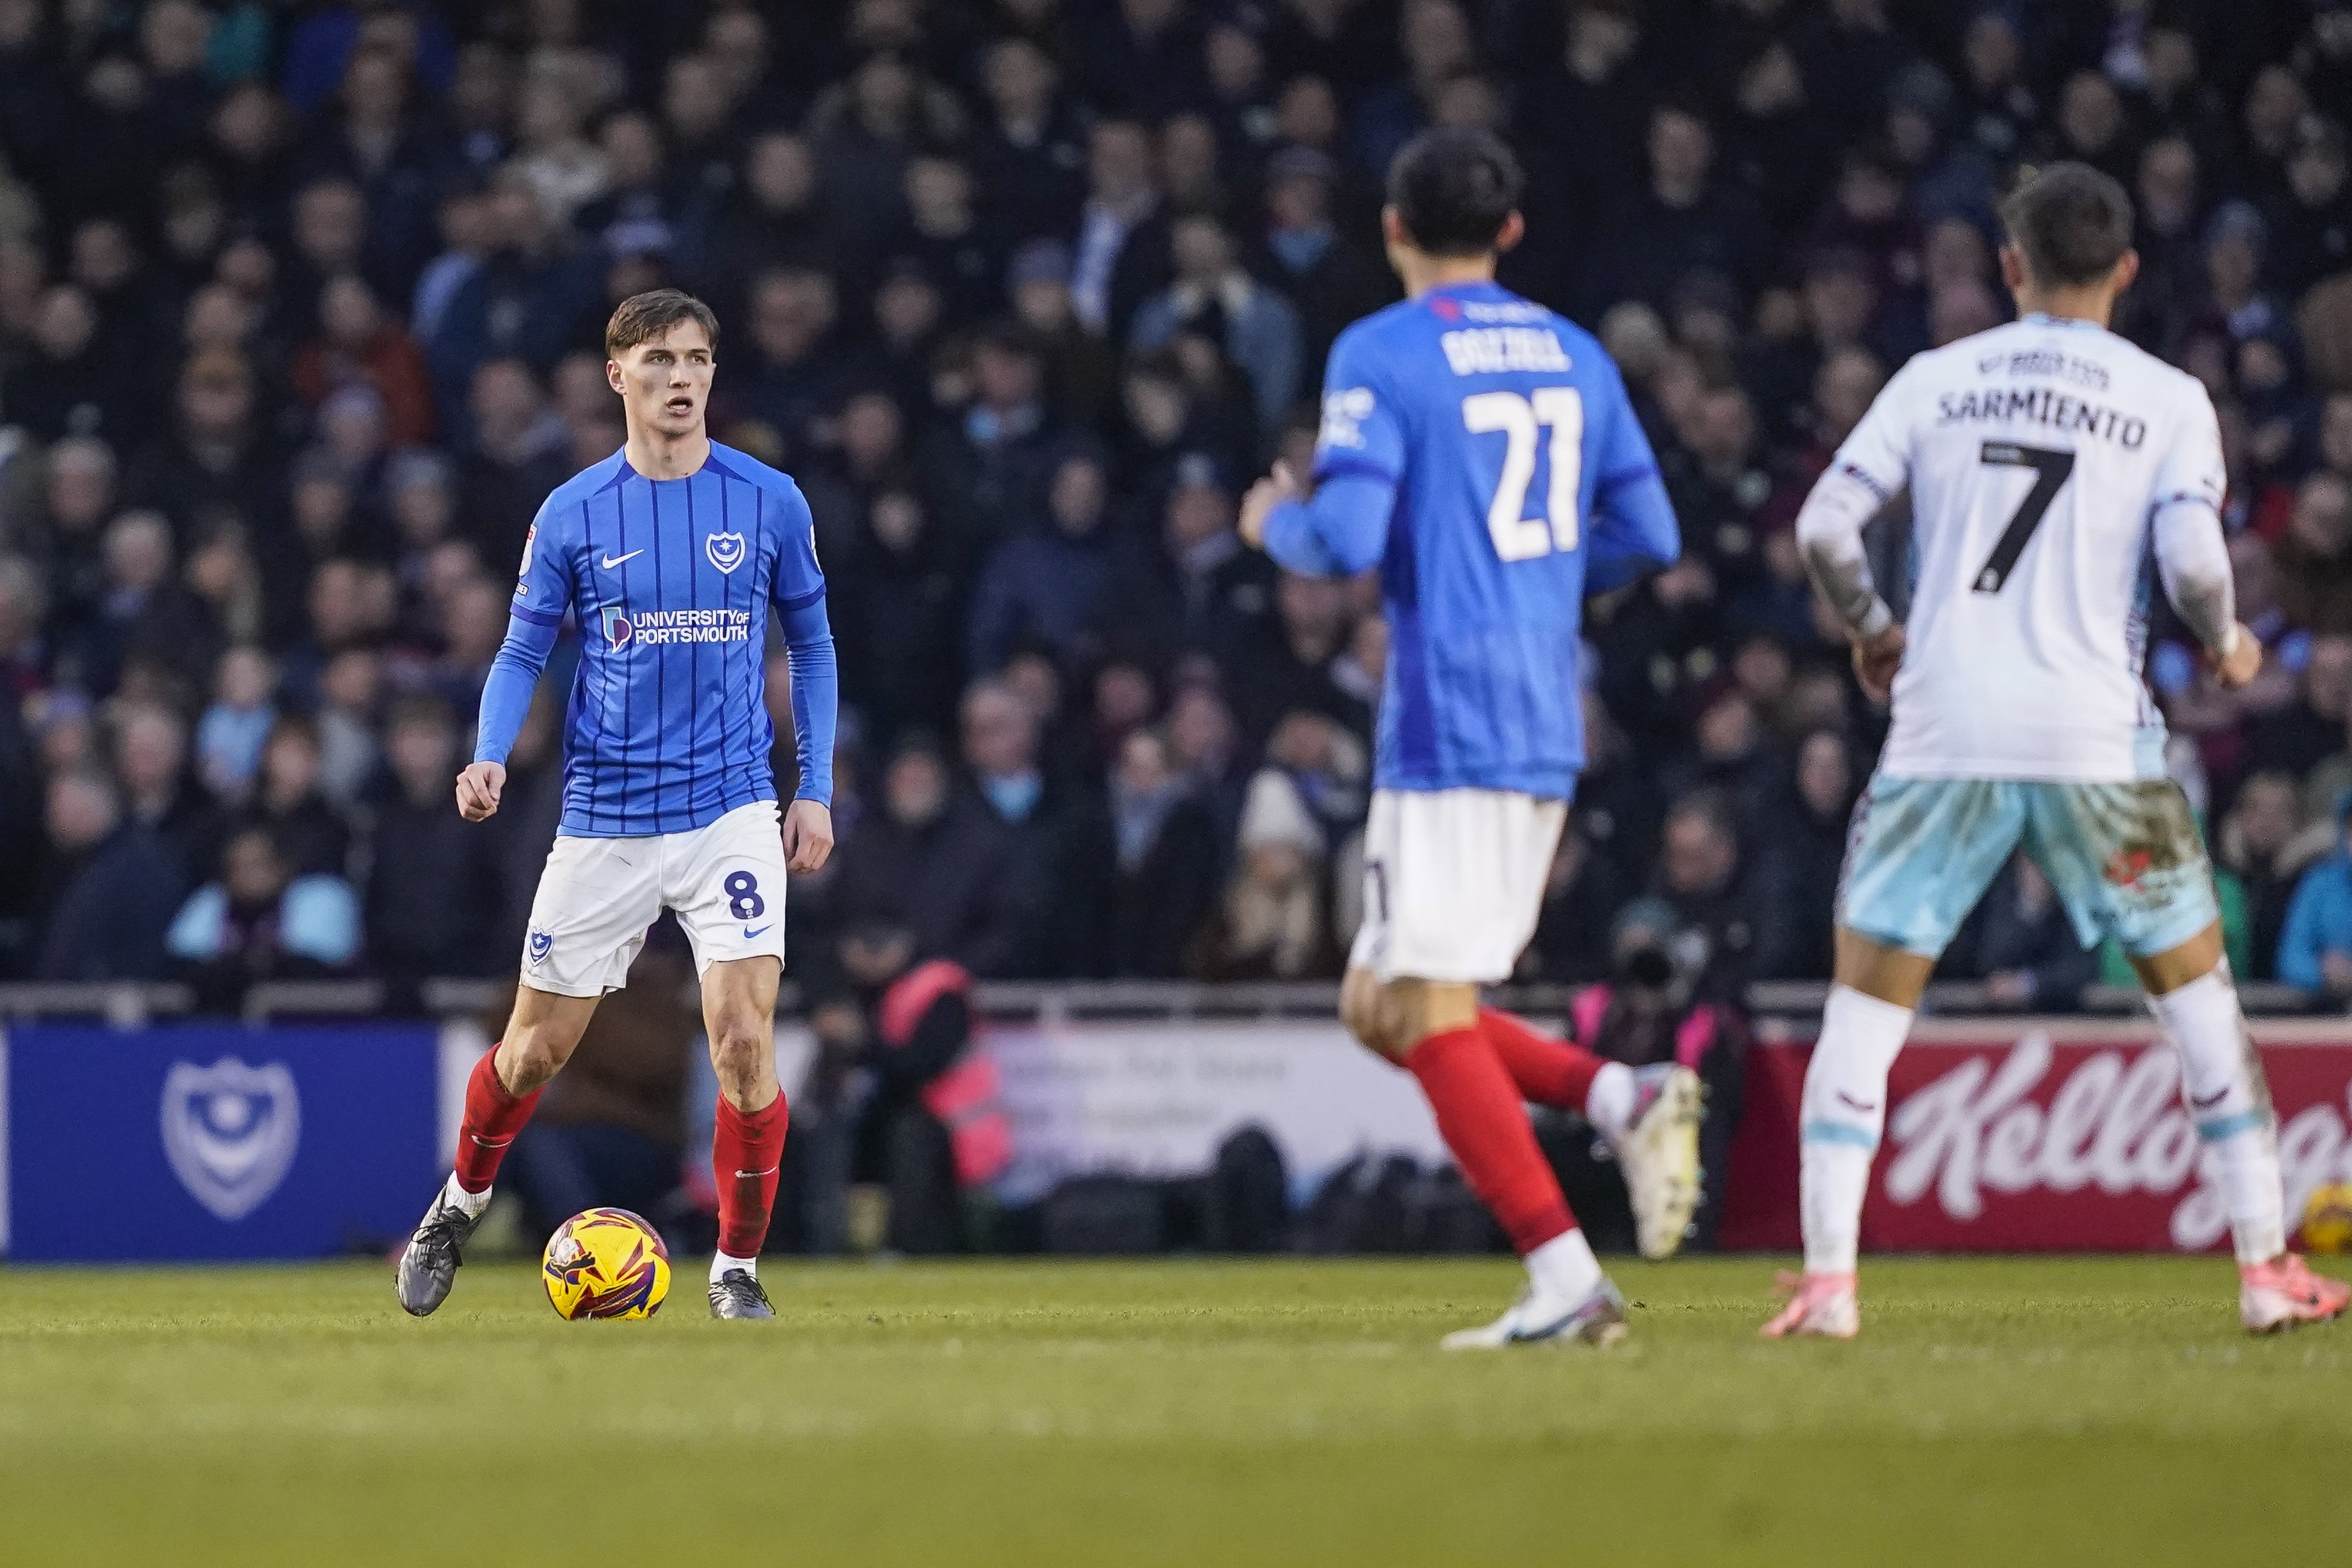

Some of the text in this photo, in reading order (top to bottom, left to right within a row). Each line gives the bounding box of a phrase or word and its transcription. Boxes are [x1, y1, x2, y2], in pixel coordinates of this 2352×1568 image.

[1937, 386, 2148, 450] SARMIENTO
[1462, 386, 1583, 563] 21
[1972, 439, 2076, 594] 7
[633, 610, 750, 628] UNIVERSITY OF
[635, 624, 749, 645] PORTSMOUTH
[724, 871, 765, 920] 8
